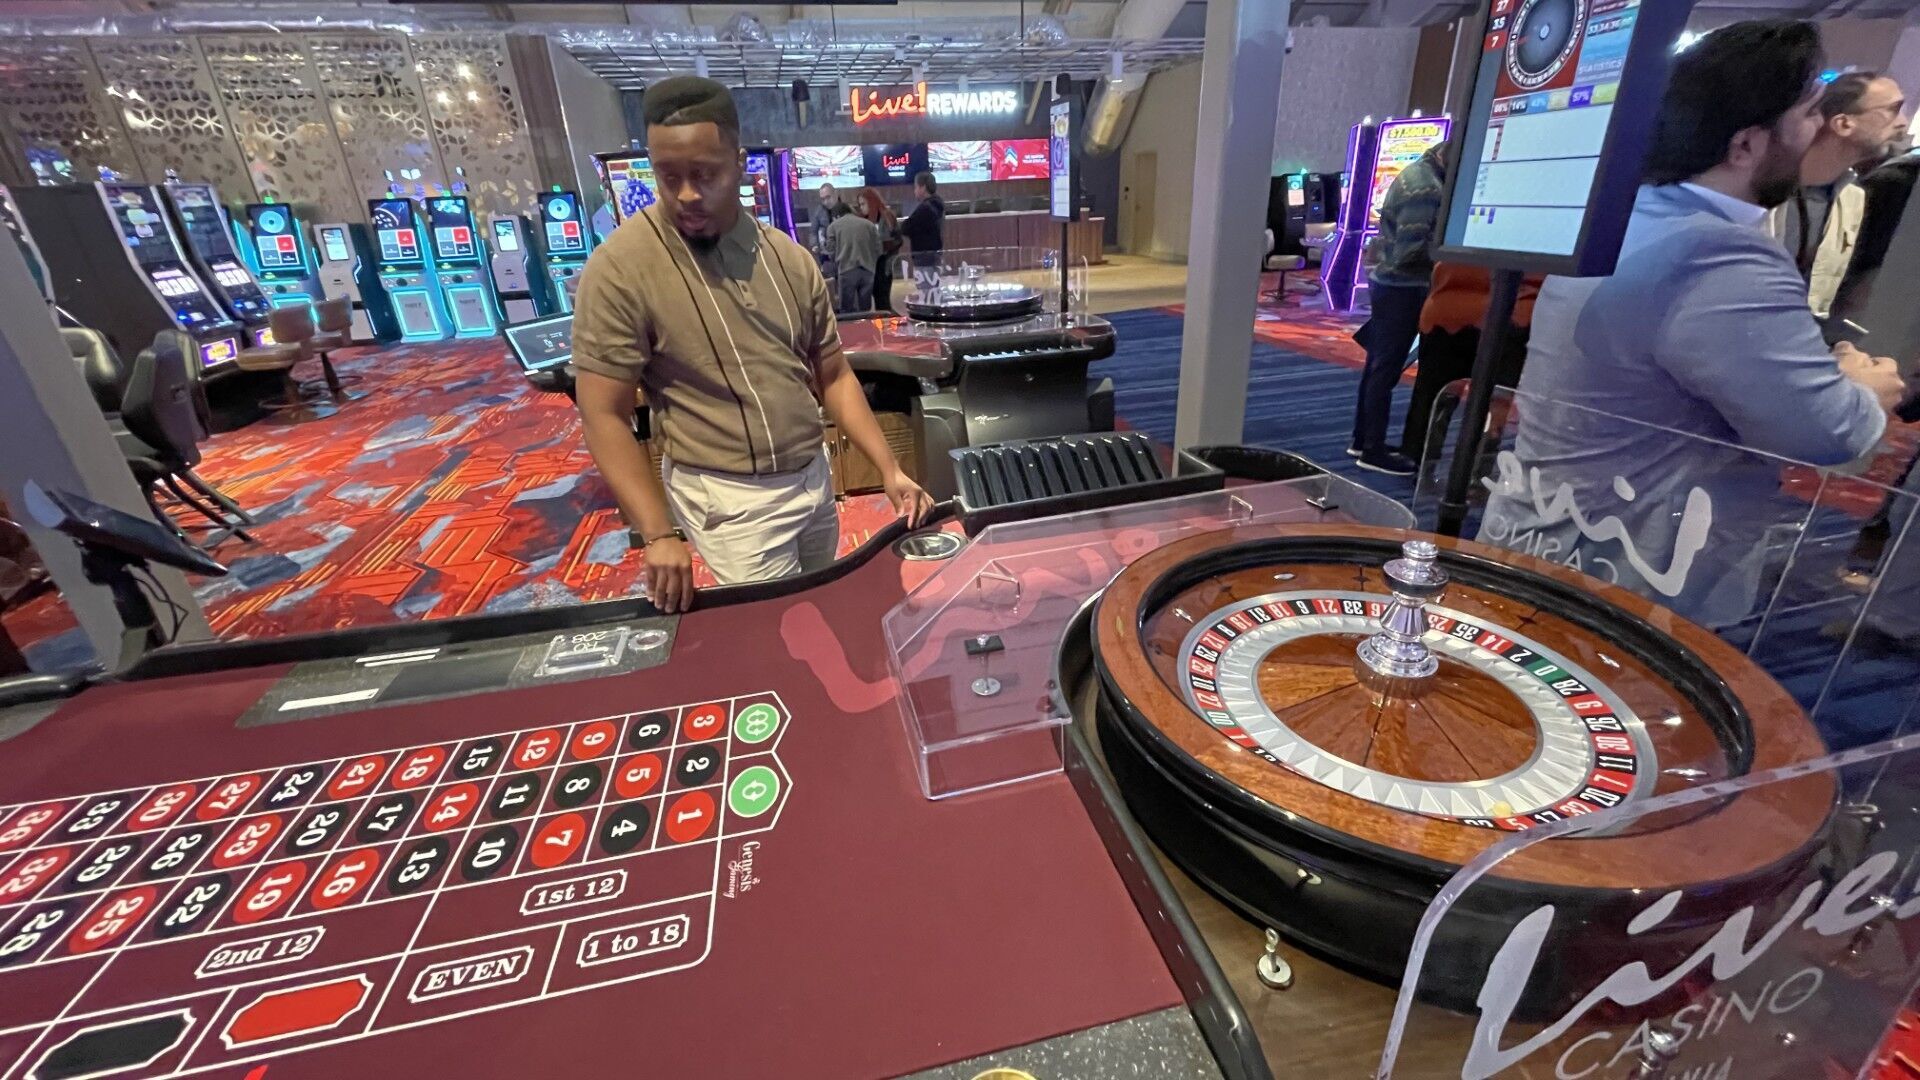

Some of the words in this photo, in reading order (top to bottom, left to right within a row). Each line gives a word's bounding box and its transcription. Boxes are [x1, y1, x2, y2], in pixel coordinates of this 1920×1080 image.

[1492, 16, 1506, 30] 35
[1491, 36, 1499, 48] 7
[851, 80, 927, 124] Live!
[927, 90, 1017, 115] REWARDS
[883, 152, 909, 168] Live!
[1248, 606, 1271, 624] 31
[1268, 603, 1291, 618] 18
[1296, 600, 1310, 615] 6
[1318, 599, 1339, 614] 21
[1343, 599, 1363, 615] 33
[1217, 624, 1236, 638] 8
[1229, 613, 1252, 630] 19
[571, 630, 608, 643] 208
[1452, 623, 1478, 641] 35
[1484, 635, 1506, 650] 14
[1195, 645, 1219, 662] 29
[1510, 649, 1532, 662] 2
[1534, 665, 1556, 676] 0
[1191, 675, 1216, 691] 10
[1552, 678, 1587, 695] 28
[1197, 691, 1223, 708] 27
[693, 715, 716, 728] 3
[1207, 711, 1235, 726] 00
[1585, 717, 1622, 731] 26
[583, 732, 606, 746] 9
[638, 724, 661, 737] 6
[521, 736, 551, 762] 12
[1595, 735, 1630, 751] 30
[401, 755, 435, 781] 18
[462, 746, 493, 771] 15
[686, 757, 710, 772] 2
[1599, 755, 1633, 770] 11
[337, 762, 376, 790] 21
[626, 767, 651, 783] 5
[1594, 773, 1628, 788] 7
[208, 781, 252, 809] 27
[271, 771, 314, 802] 24
[564, 777, 591, 794] 8
[499, 784, 530, 808] 11
[1579, 787, 1620, 807] 20
[139, 791, 187, 822] 30
[432, 793, 468, 823] 14
[677, 808, 703, 824] 1
[69, 801, 121, 832] 33
[367, 803, 404, 831] 17
[1534, 810, 1561, 823] 17
[0, 810, 53, 843] 36
[296, 811, 340, 846] 20
[610, 819, 638, 838] 4
[224, 822, 272, 858] 23
[545, 828, 574, 847] 7
[151, 833, 202, 870] 26
[472, 838, 506, 868] 10
[77, 845, 131, 882] 29
[398, 848, 438, 883] 13
[740, 840, 761, 892] Genesis
[0, 857, 58, 895] 32
[322, 860, 366, 898] 16
[247, 873, 292, 911] 19
[533, 885, 576, 907] 1st
[583, 878, 615, 898] 12
[164, 883, 221, 926] 22
[84, 896, 144, 940] 25
[0, 909, 64, 956] 28
[585, 940, 600, 960] 1
[610, 934, 638, 955] to
[647, 923, 680, 946] 18
[206, 940, 270, 970] 2nd
[273, 934, 313, 958] 12
[423, 954, 522, 993] EVEN
[1555, 967, 1825, 1080] CASINO
